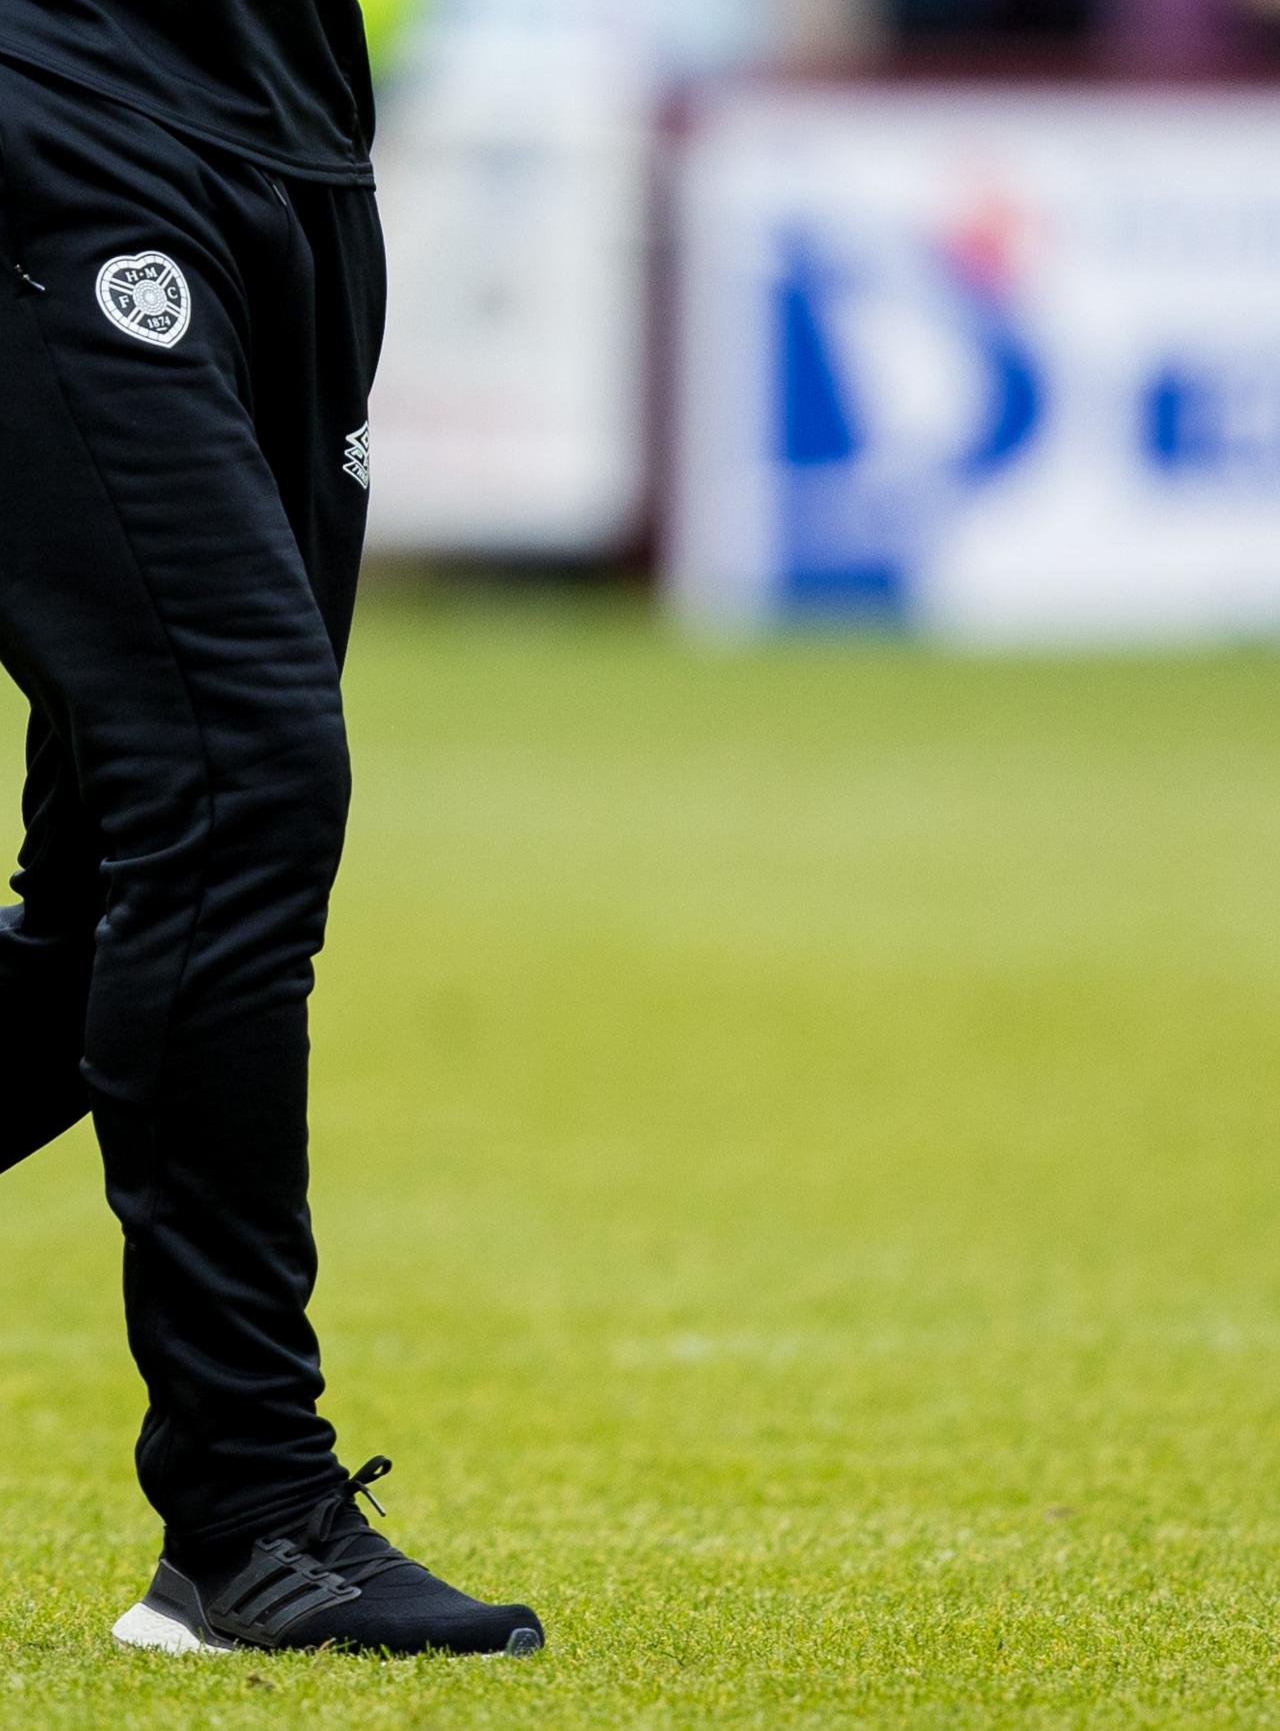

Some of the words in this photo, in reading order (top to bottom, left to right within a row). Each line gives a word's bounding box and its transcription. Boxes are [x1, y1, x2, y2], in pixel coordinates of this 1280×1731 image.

[118, 295, 130, 309] F
[167, 286, 178, 299] C
[147, 316, 171, 329] 1874
